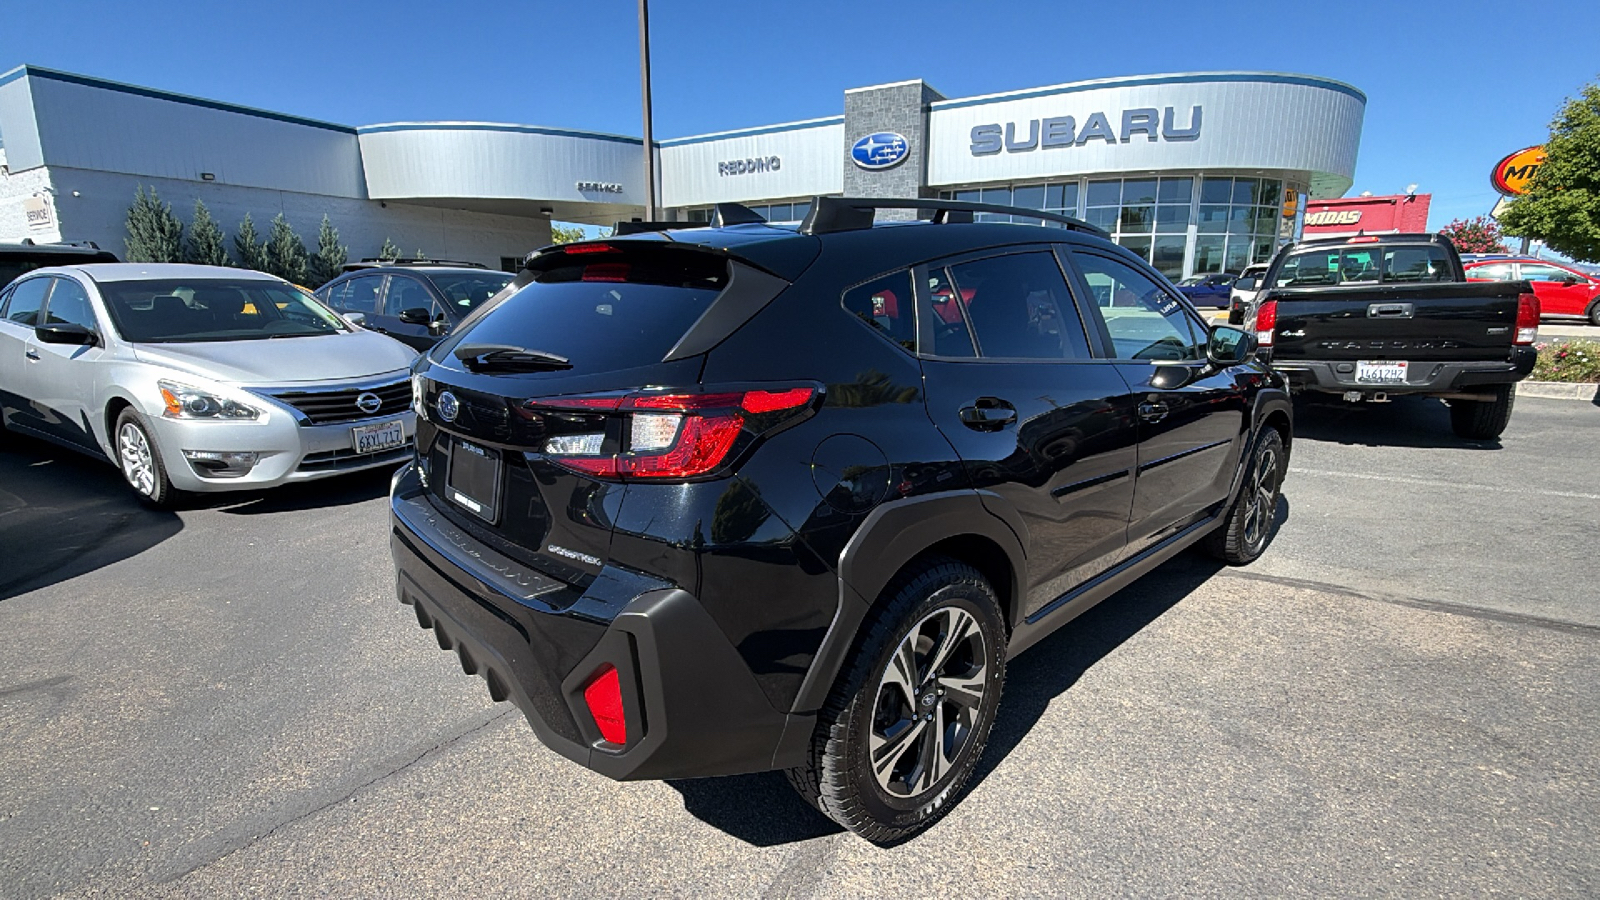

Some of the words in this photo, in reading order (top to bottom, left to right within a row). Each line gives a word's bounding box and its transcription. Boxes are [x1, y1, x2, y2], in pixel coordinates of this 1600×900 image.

[970, 105, 1202, 157] SUBARU
[718, 156, 781, 177] REDDING
[577, 182, 623, 194] SERVICE
[26, 208, 48, 222] SERVICE
[1304, 210, 1362, 226] MIDAS
